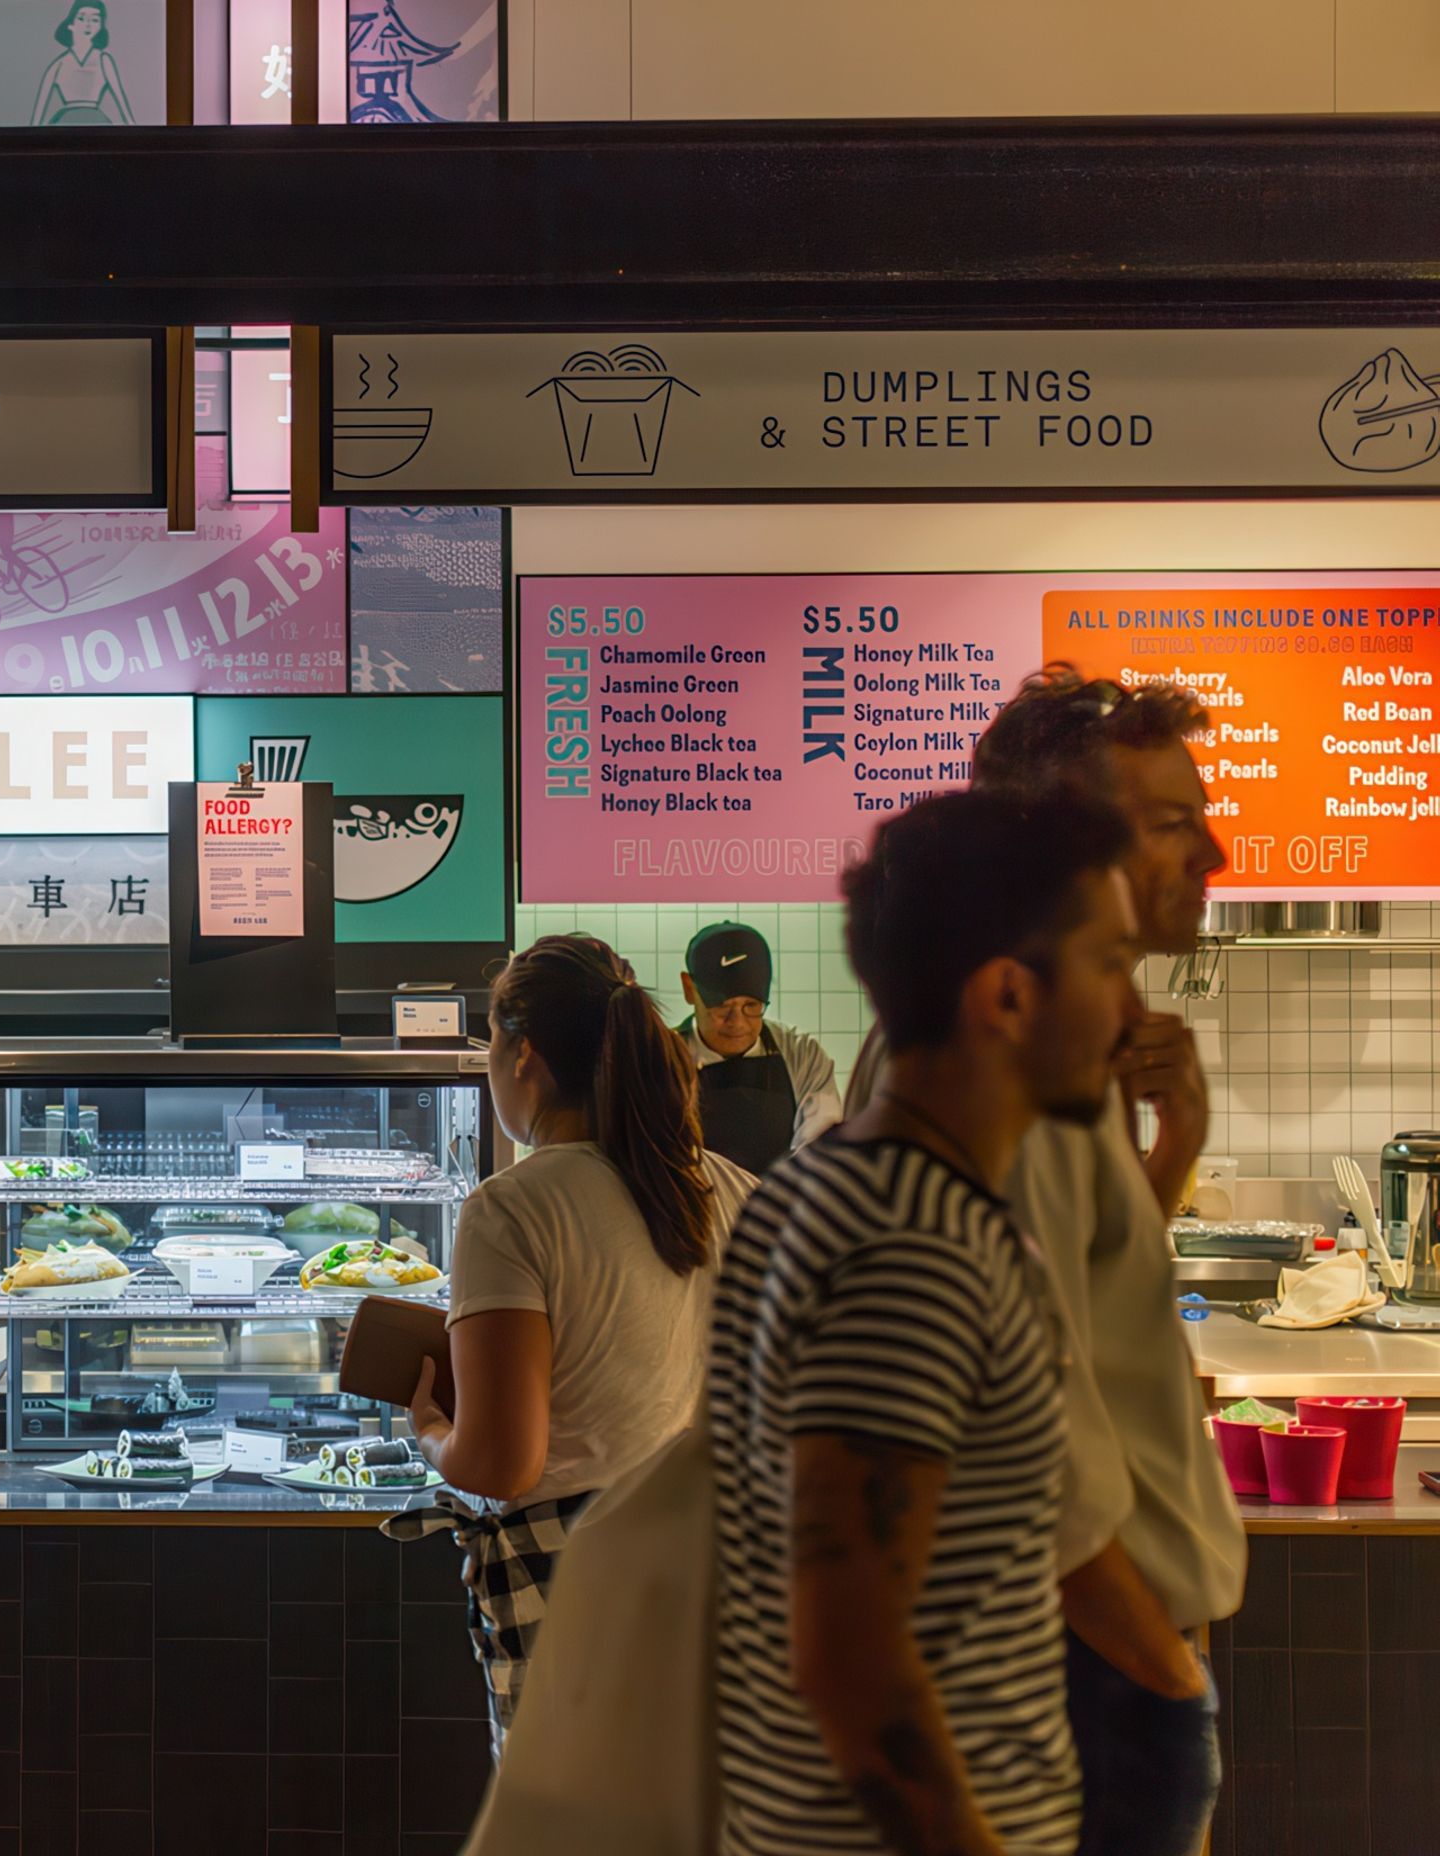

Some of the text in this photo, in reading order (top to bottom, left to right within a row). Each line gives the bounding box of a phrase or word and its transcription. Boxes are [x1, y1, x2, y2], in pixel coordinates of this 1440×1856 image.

[822, 369, 1092, 403] DUMPLINGS
[760, 414, 1153, 449] & STREET FOOD
[547, 604, 646, 638] $5.50
[803, 604, 900, 634] $5.50
[1068, 610, 1109, 629] ALL
[1117, 609, 1206, 629] DRINKS
[1213, 608, 1315, 628] INCLUDE
[1322, 608, 1369, 628] ONE
[60, 629, 125, 688] 10
[600, 645, 766, 664] Chamomile Green
[854, 643, 994, 666] Honey Milk Tea
[600, 675, 739, 694] Jasmine Green
[854, 673, 1001, 696] Oolong Milk Tea
[1341, 666, 1433, 686] Aloe Vera
[601, 704, 727, 727] Peach Oolong
[802, 647, 845, 764] MILK
[854, 703, 944, 726] Signature
[950, 702, 990, 721] Milk
[1343, 701, 1433, 722] Red Bean
[545, 646, 591, 798] FRESH
[1220, 722, 1280, 743] Pearls
[601, 733, 757, 757] Lychee Black tea
[854, 732, 918, 756] Ceylon
[923, 732, 964, 751] Milk
[1321, 734, 1440, 755] Coconut Jell
[601, 762, 783, 787] Signature Black tea
[854, 762, 933, 781] Coconut
[1219, 758, 1279, 779] Pearls
[1349, 765, 1428, 791] Pudding
[204, 800, 251, 815] FOOD
[601, 792, 752, 816] Honey Black tea
[853, 792, 894, 811] Taro
[1325, 796, 1440, 821] Rainbow jell
[204, 818, 293, 835] ALLERGY?
[1232, 835, 1369, 874] IT OFF
